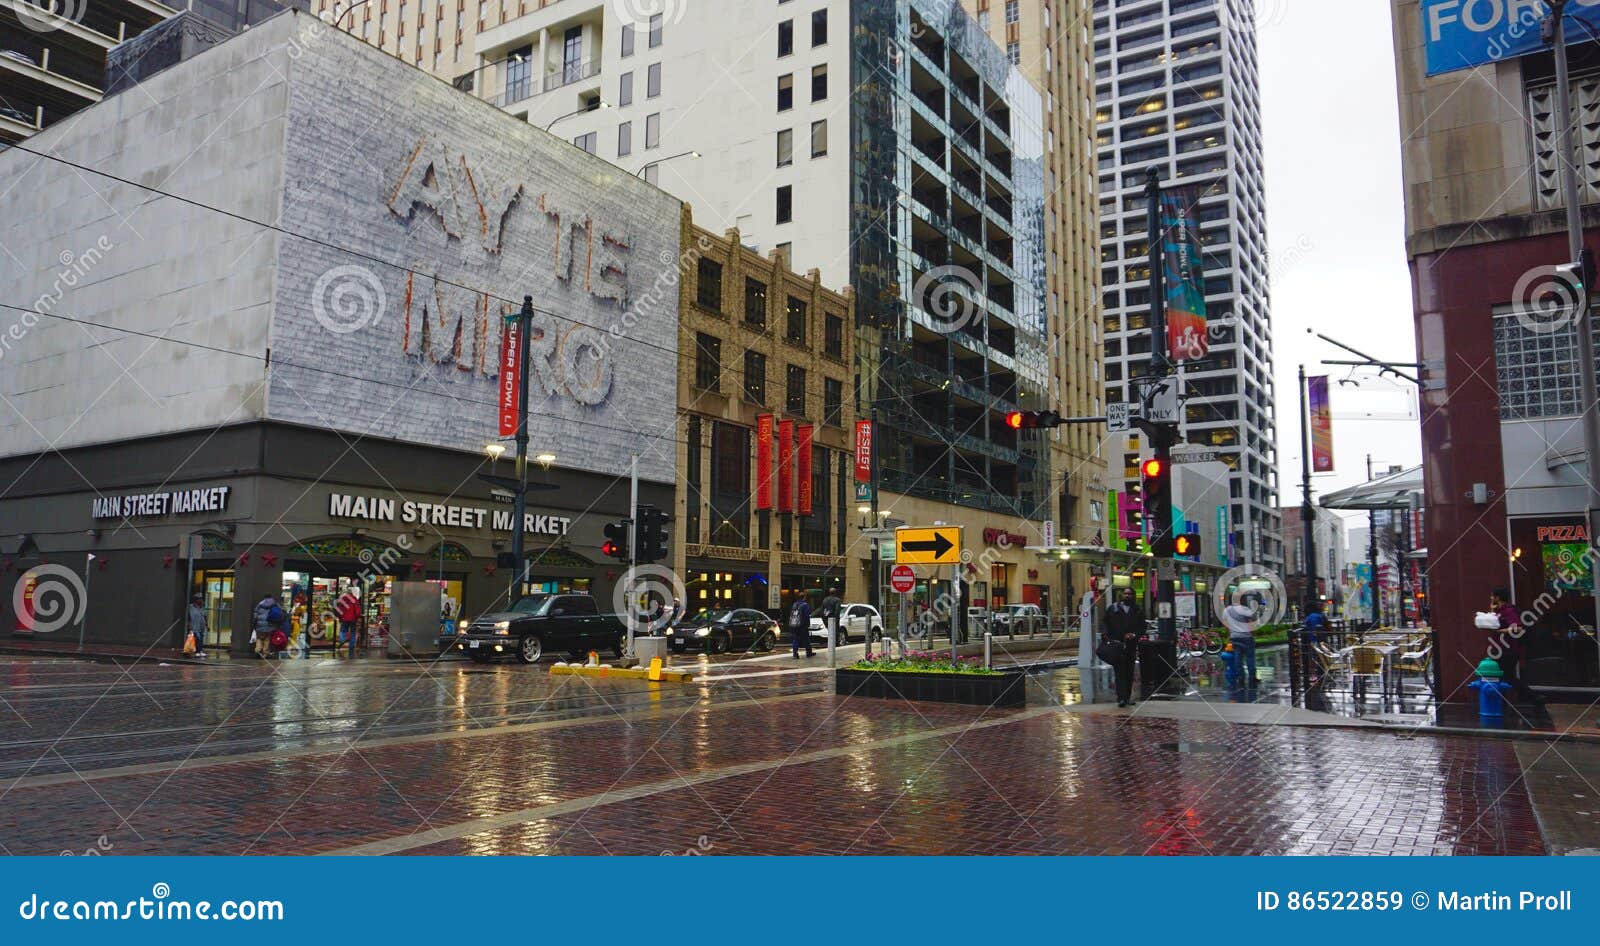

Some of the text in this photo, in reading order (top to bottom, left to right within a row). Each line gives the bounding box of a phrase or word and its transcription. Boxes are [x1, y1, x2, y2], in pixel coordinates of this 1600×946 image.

[506, 321, 517, 367] SUPER
[504, 371, 513, 410] BOWL
[1109, 412, 1126, 420] WAY
[1175, 451, 1216, 463] WALKER
[92, 486, 228, 518] MAIN STREET MARKET
[330, 493, 395, 521] MAIN
[402, 501, 487, 529] STREET
[1537, 525, 1589, 541] PIZZA
